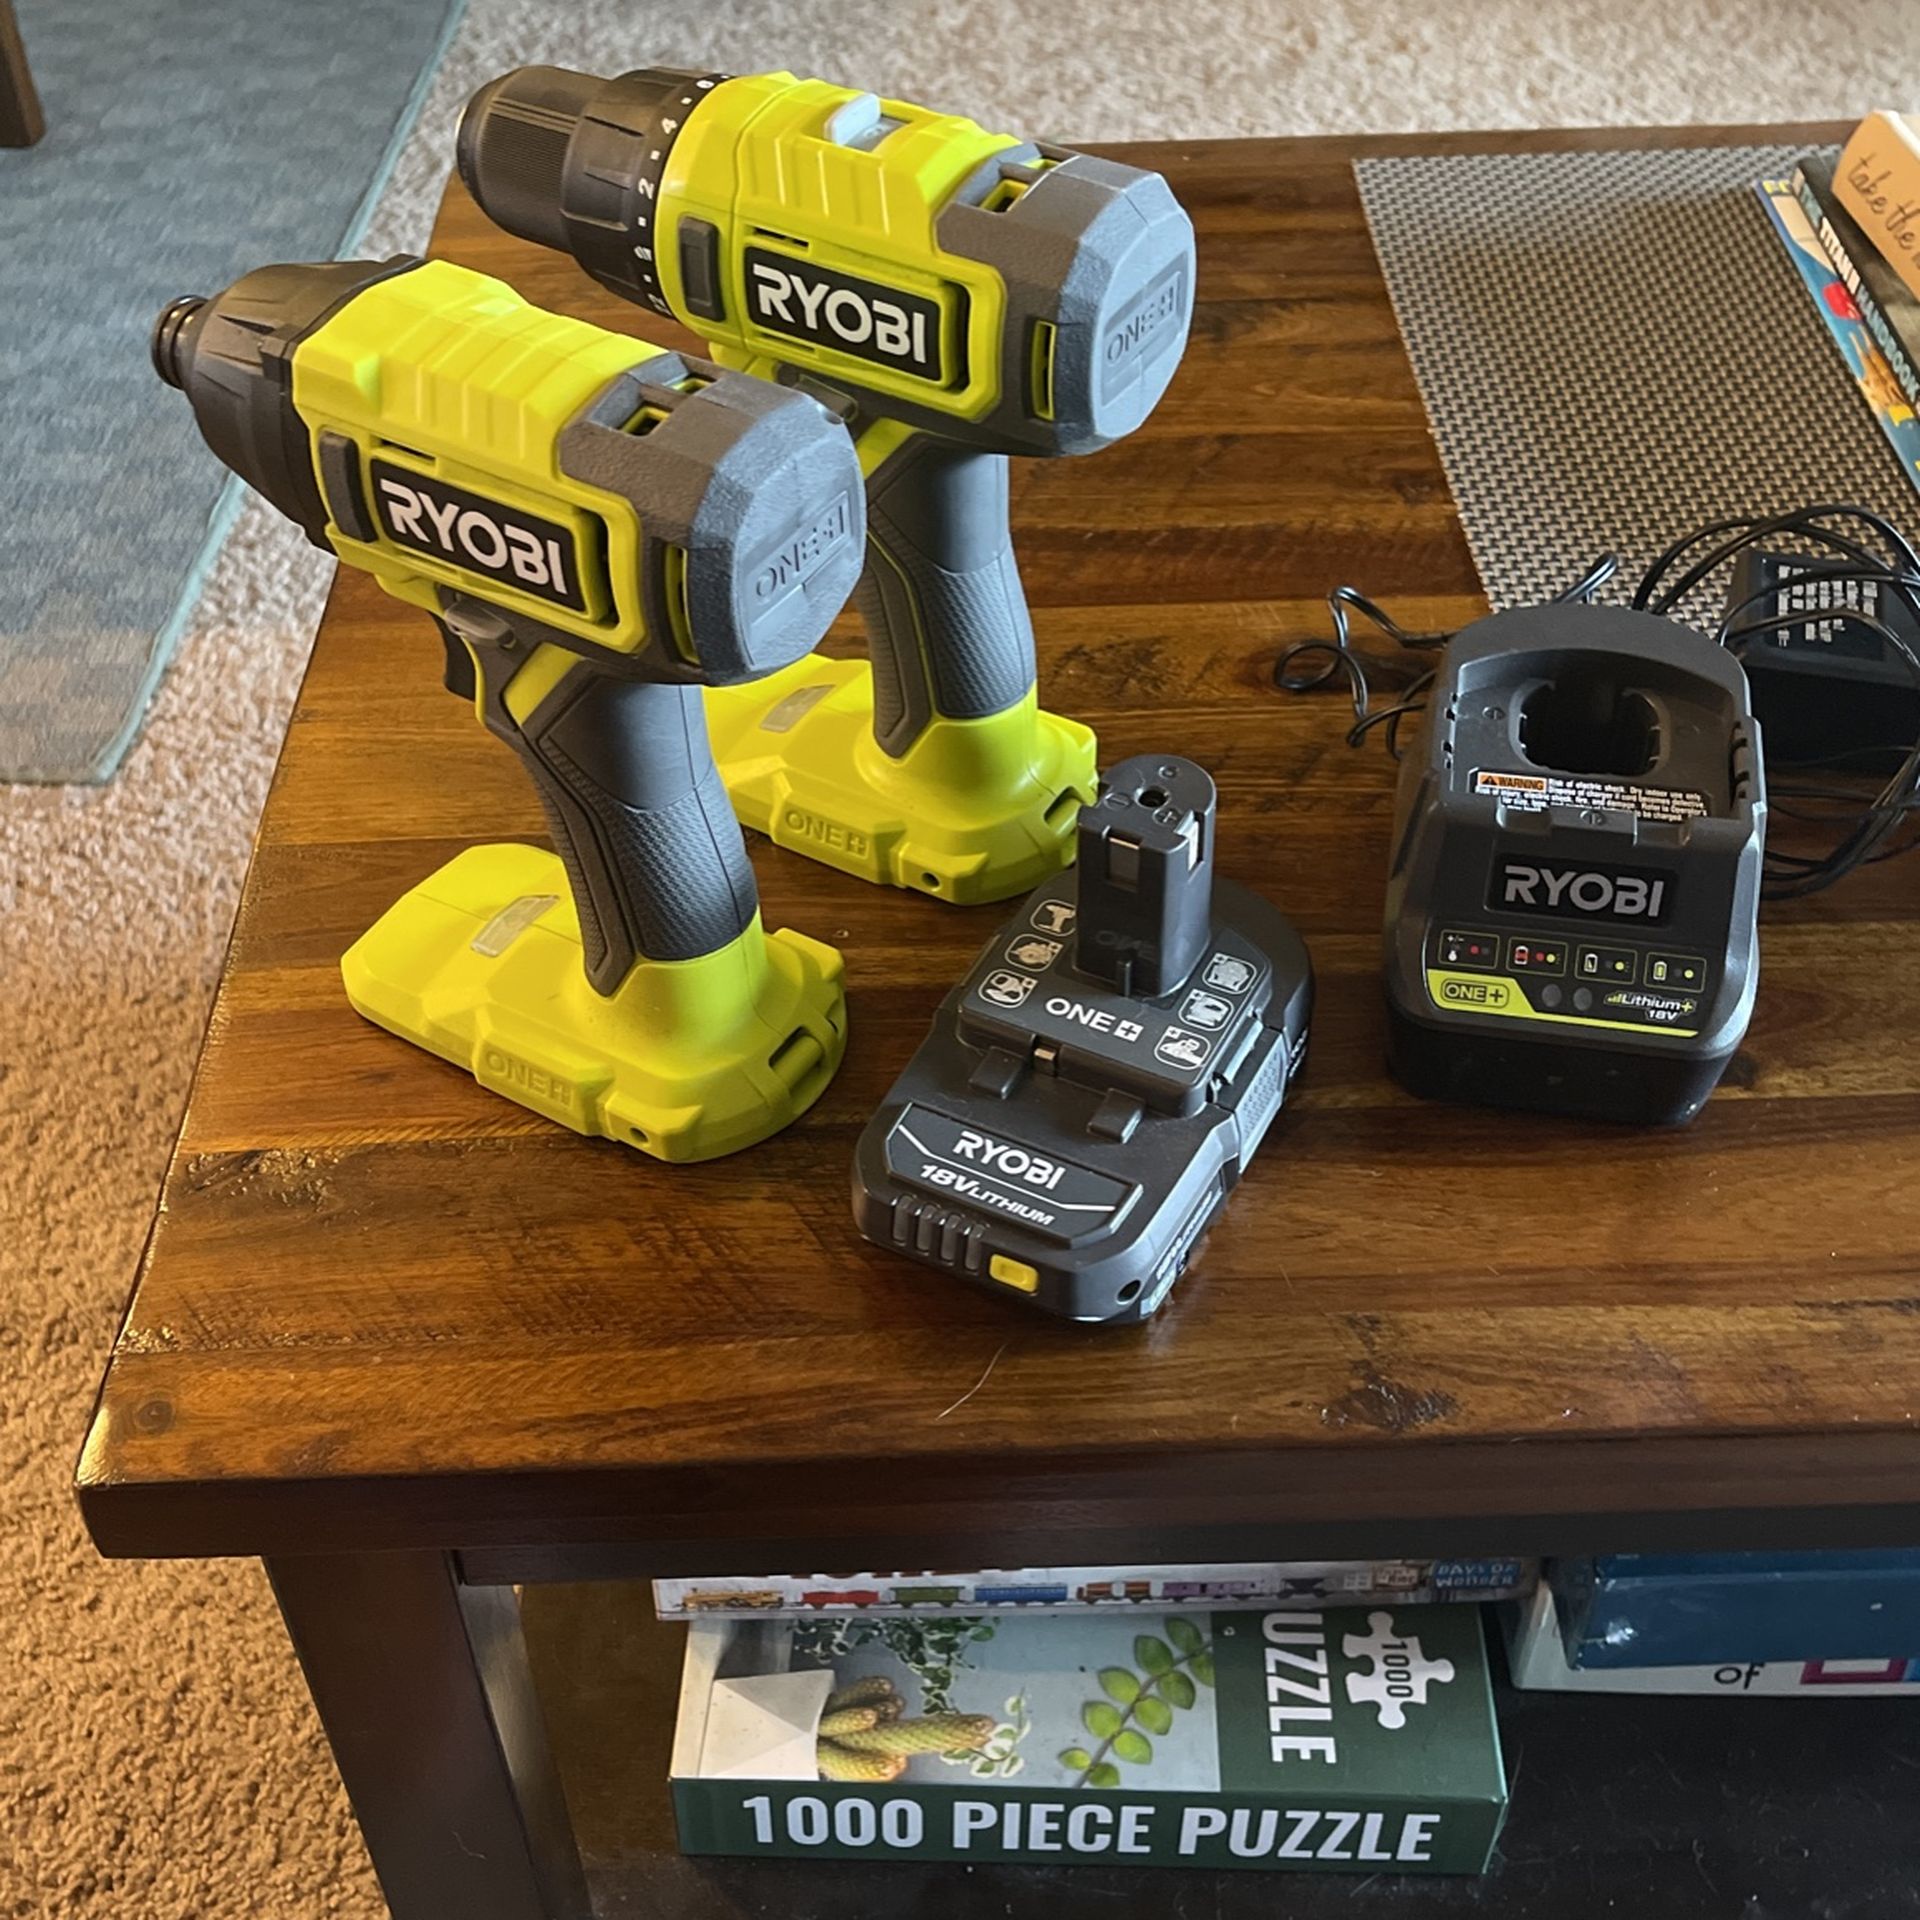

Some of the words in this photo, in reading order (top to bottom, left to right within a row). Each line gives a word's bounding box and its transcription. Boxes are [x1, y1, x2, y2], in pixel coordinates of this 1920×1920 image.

[661, 117, 678, 135] 4
[638, 177, 655, 200] 2
[1847, 152, 1892, 214] take
[753, 263, 927, 364] RYOBI
[1855, 282, 1920, 403] HANDBOOK
[380, 478, 568, 595] RYOBI
[1499, 776, 1544, 791] WARNING
[785, 809, 870, 860] ONE+
[1504, 864, 1665, 918] RYOBI
[1045, 997, 1145, 1042] ONE+
[1445, 983, 1504, 1004] ONE+
[1648, 1008, 1679, 1021] 18V
[953, 1130, 1066, 1190] RYOBI
[1381, 1640, 1414, 1698] 1000
[743, 1796, 924, 1848] 1000
[953, 1801, 1155, 1853] PIECE
[1178, 1806, 1441, 1861] PUZZLE
